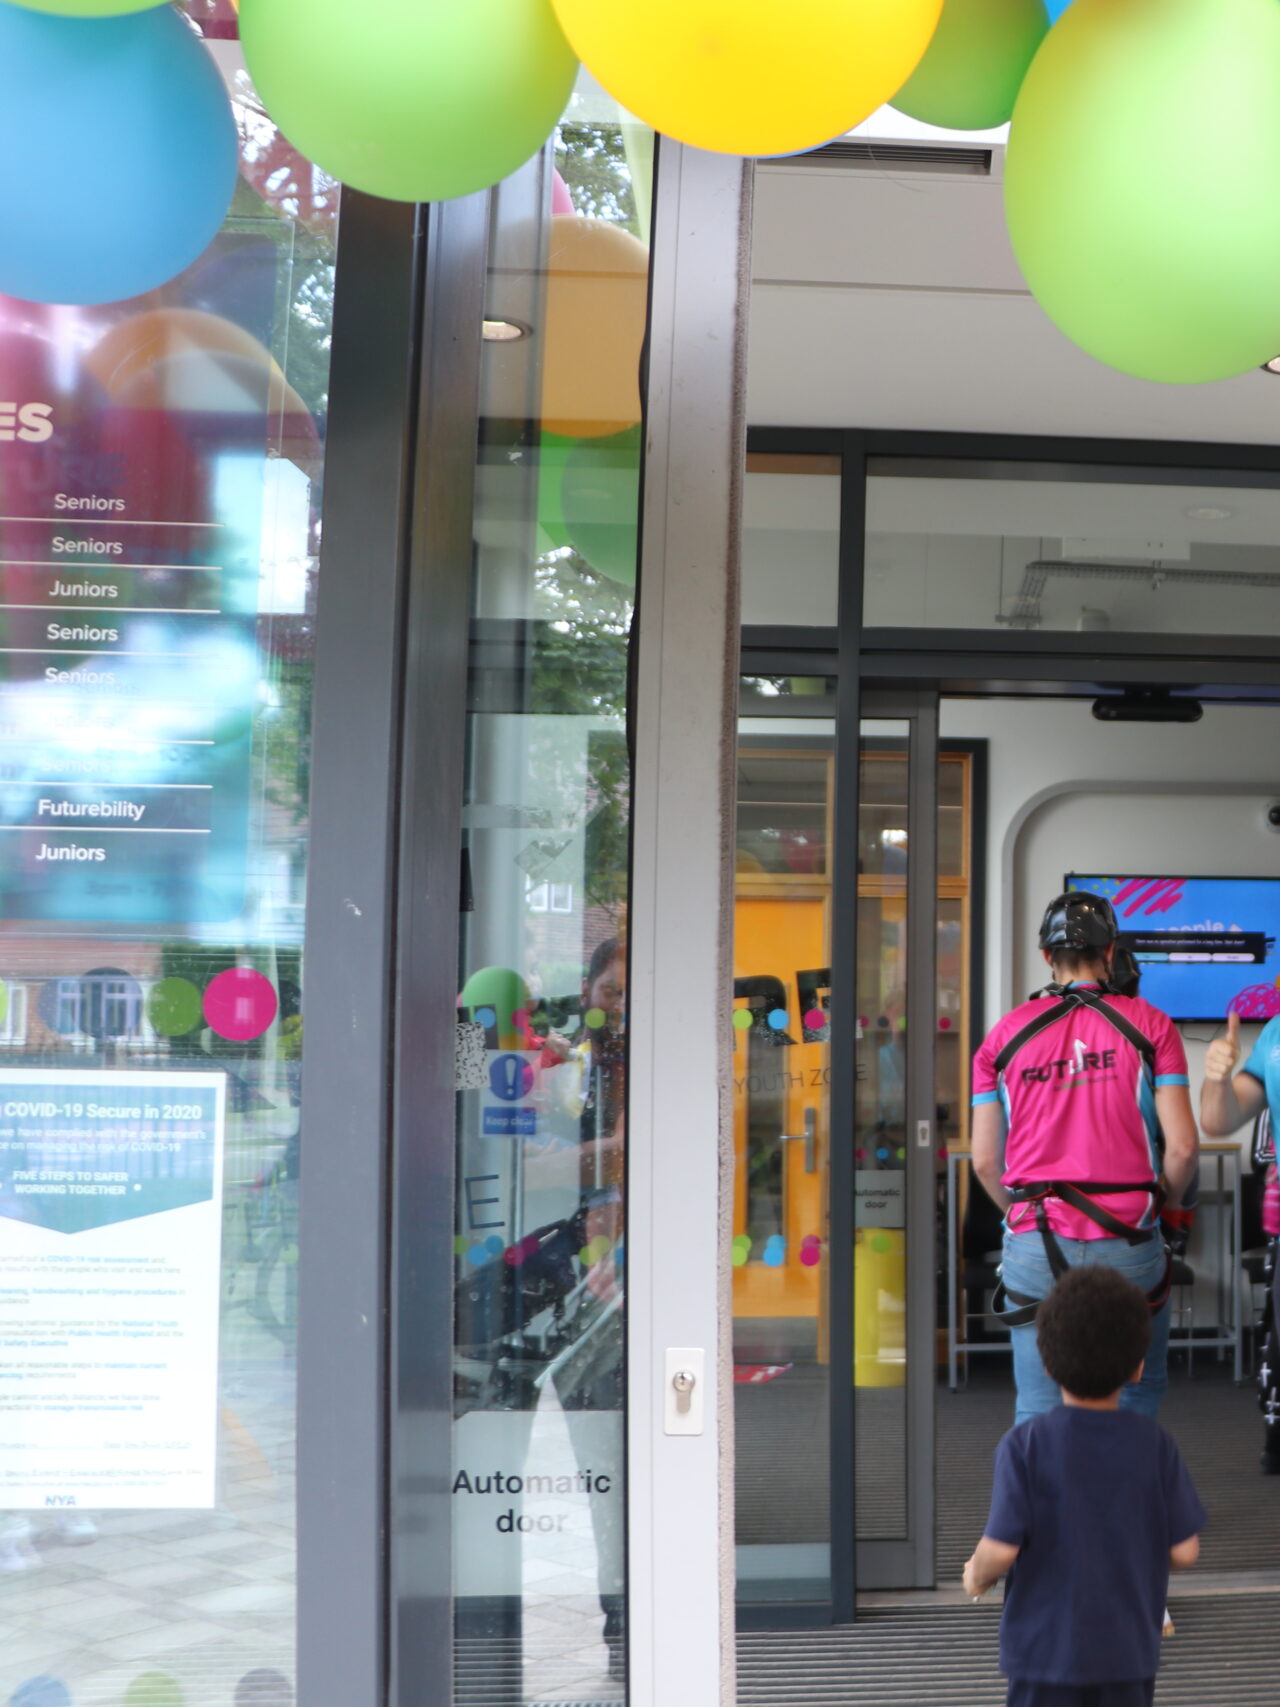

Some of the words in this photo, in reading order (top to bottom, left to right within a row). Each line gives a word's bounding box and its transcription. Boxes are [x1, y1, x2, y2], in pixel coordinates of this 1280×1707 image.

[54, 493, 125, 511] Seniors
[52, 537, 123, 554] Seniors
[49, 580, 118, 597] Juniors
[47, 624, 118, 641] Seniors
[45, 667, 115, 684] Seniors
[38, 799, 145, 821] Futurebility
[36, 844, 106, 861] Juniors
[1022, 1039, 1117, 1087] FUTURE
[733, 1071, 804, 1095] YOUTH
[810, 1064, 867, 1087] ZOE
[4, 1102, 84, 1118] COVID-19
[87, 1104, 141, 1119] Secure
[144, 1104, 160, 1119] in
[162, 1105, 203, 1120] 2020
[13, 1171, 37, 1180] FIVE
[40, 1171, 75, 1181] STEPS
[77, 1172, 92, 1181] TO
[94, 1172, 129, 1182] SAFER
[15, 1184, 67, 1194] WORKING
[69, 1185, 126, 1195] TOGETHER
[865, 1200, 888, 1209] door
[452, 1469, 611, 1494] Automatic
[45, 1496, 76, 1507] NYA
[496, 1508, 569, 1533] door
